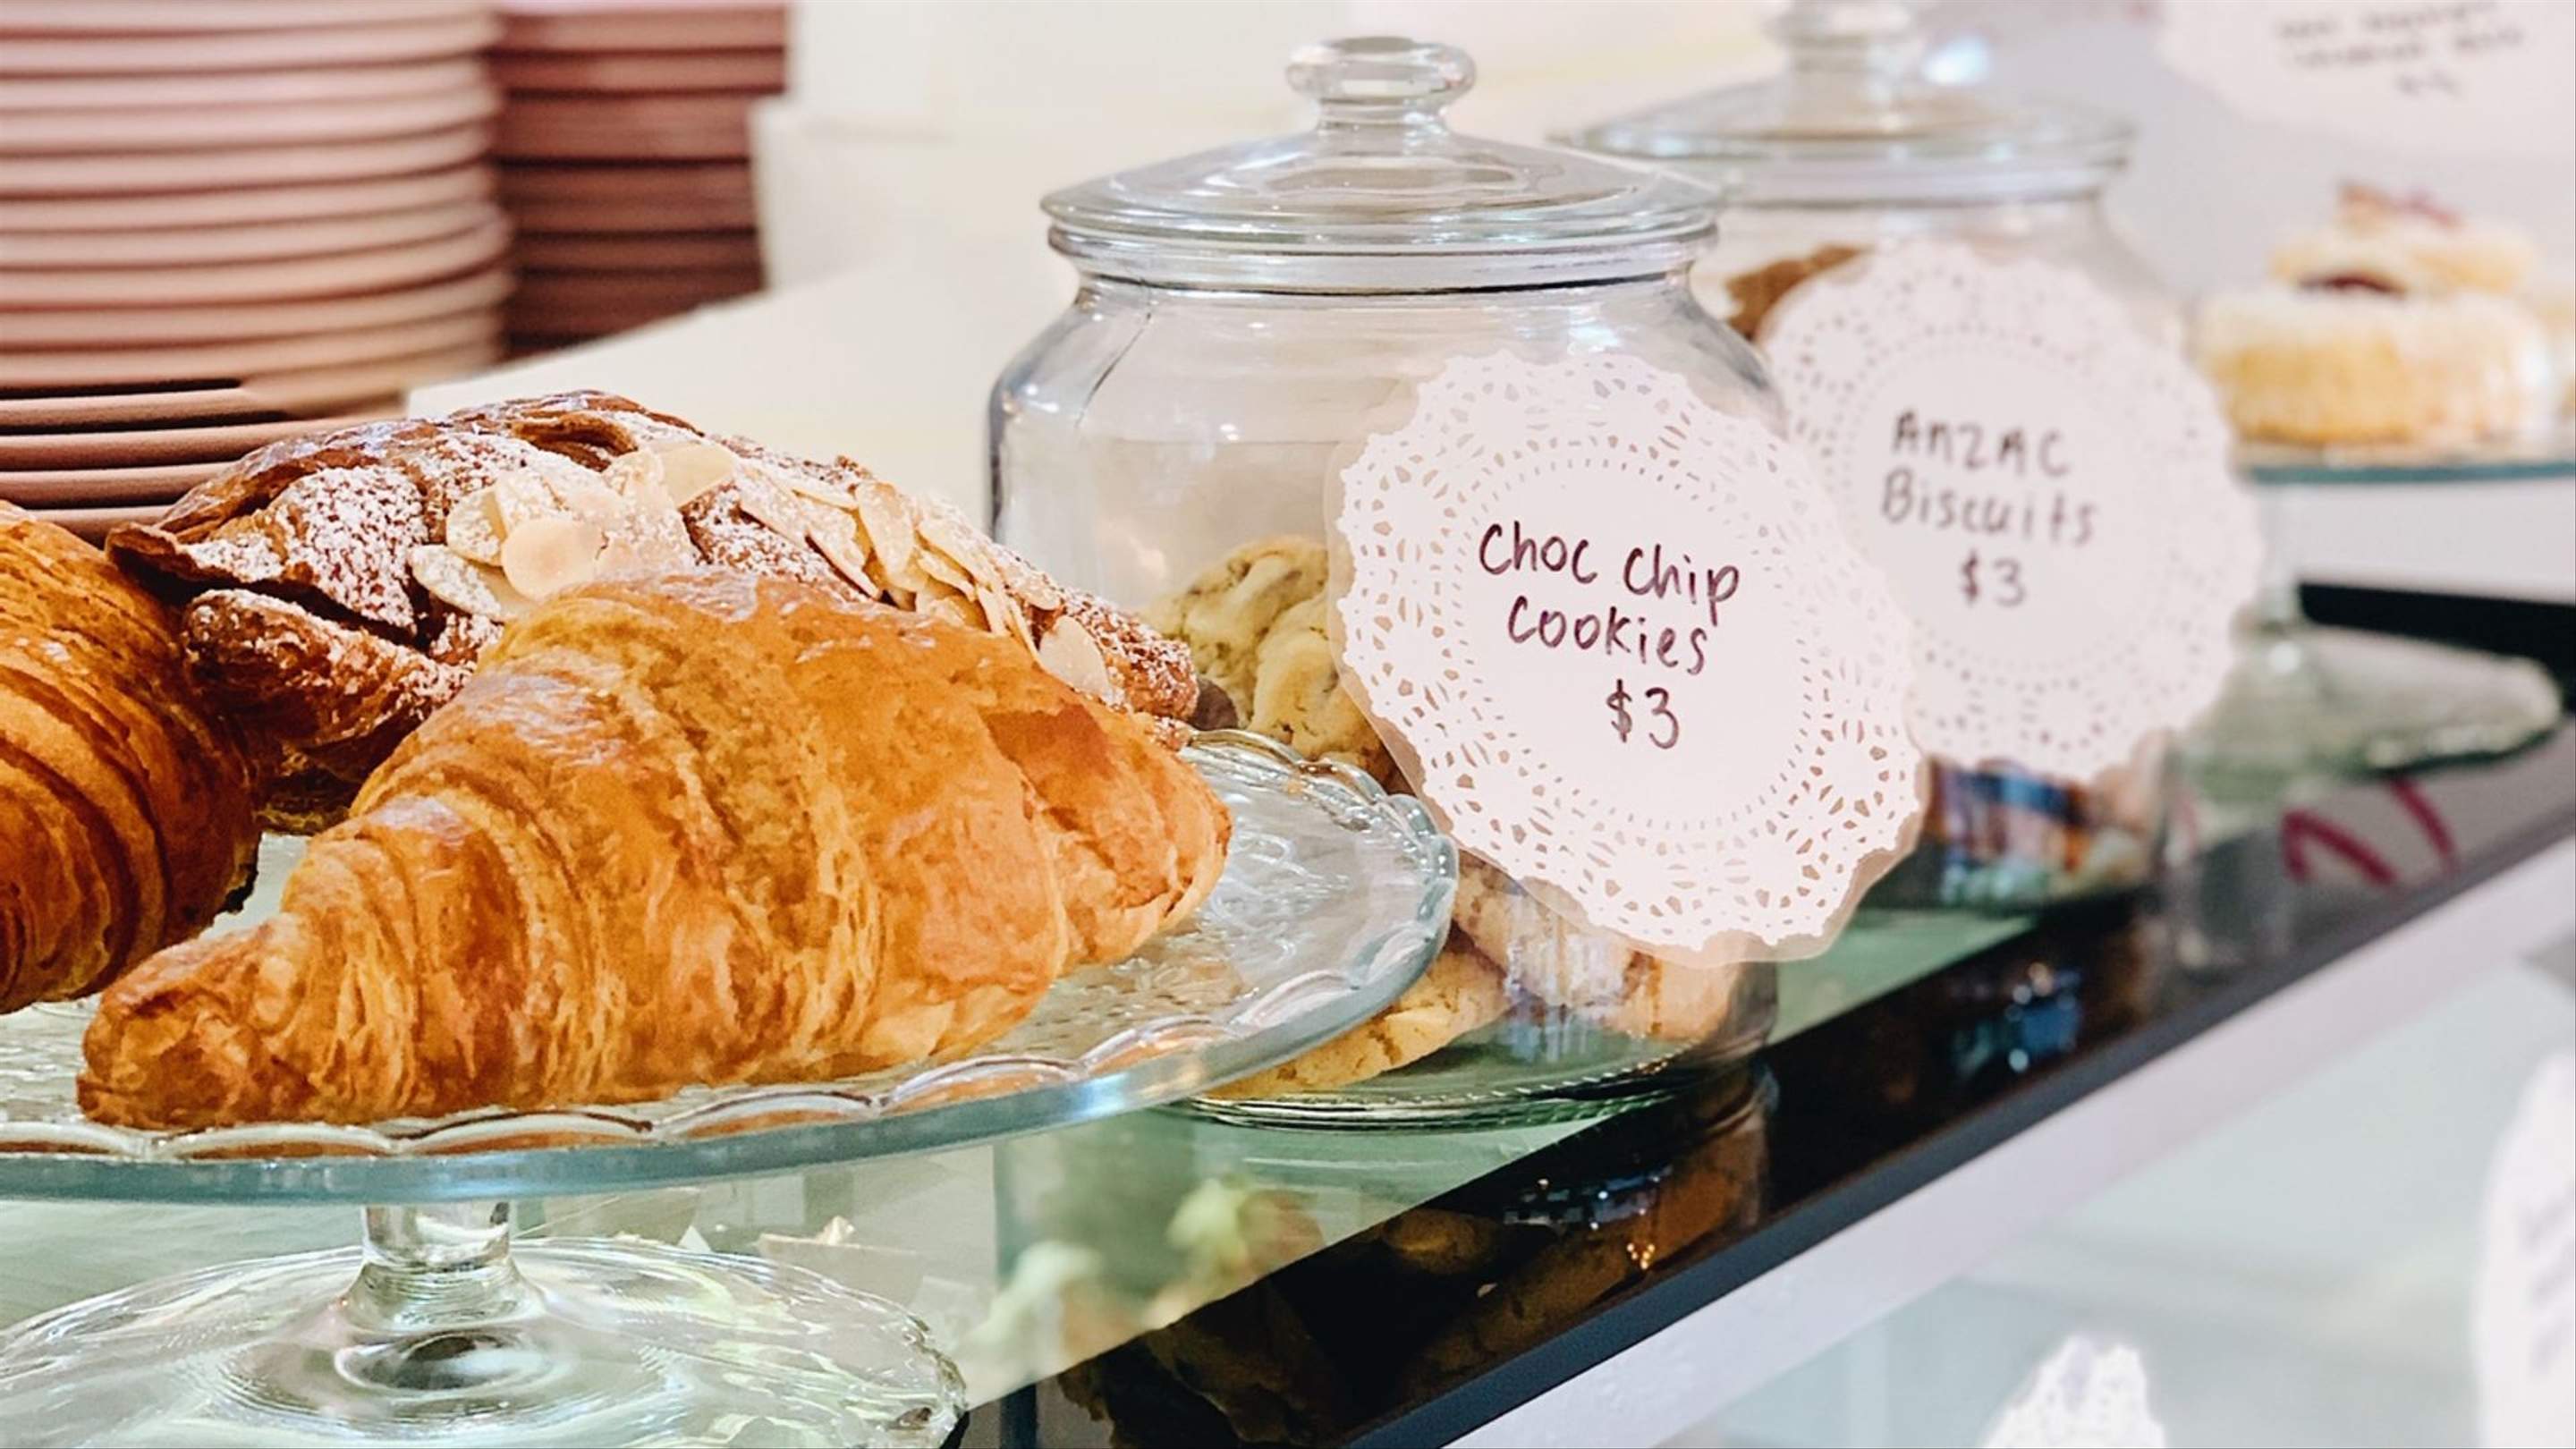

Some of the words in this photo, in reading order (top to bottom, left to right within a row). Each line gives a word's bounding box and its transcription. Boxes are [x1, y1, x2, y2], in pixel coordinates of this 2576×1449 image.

[1881, 466, 2096, 546] Biscuits
[1479, 520, 1597, 583] Choc
[1962, 549, 2027, 607] $3
[1508, 595, 1707, 674] Cookies
[1606, 678, 1680, 750] $3
